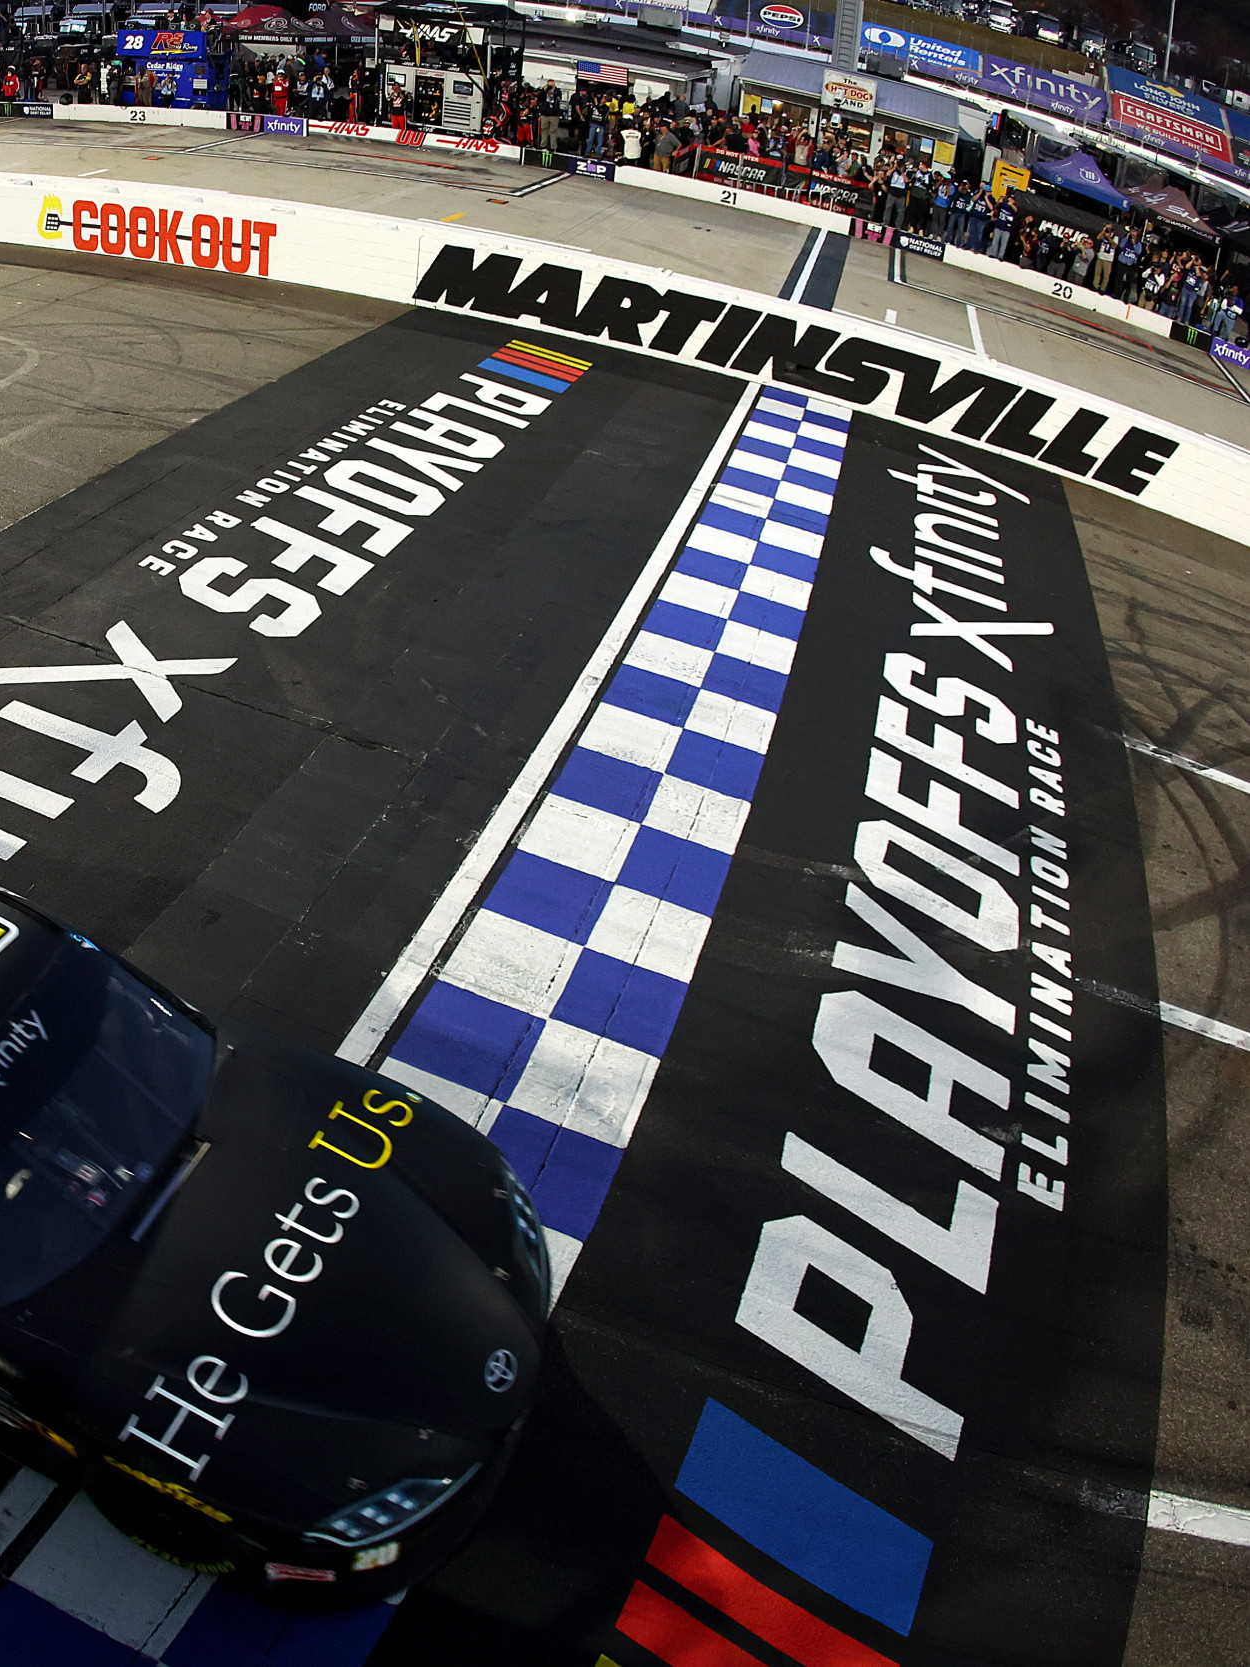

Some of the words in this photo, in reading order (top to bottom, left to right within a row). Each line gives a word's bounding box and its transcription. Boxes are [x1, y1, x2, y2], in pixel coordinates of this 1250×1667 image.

[308, 3, 327, 12] FORD
[763, 10, 801, 22] PEPSI
[755, 25, 781, 37] xfinity
[123, 34, 144, 50] 28
[910, 37, 962, 57] United
[910, 46, 966, 66] Rentals
[146, 62, 165, 70] Cedar
[166, 63, 184, 72] Ridge
[851, 90, 869, 100] DOG
[990, 63, 1102, 111] xfinity
[1133, 82, 1167, 99] LONG
[1170, 95, 1201, 112] JOHN
[130, 110, 146, 122] 23
[1127, 105, 1215, 145] CRAFTSMAN
[267, 121, 301, 134] xfinity
[1152, 128, 1180, 142] BUILD
[718, 161, 766, 181] NASCAR
[720, 190, 738, 205] 21
[814, 183, 858, 204] NASCAR
[72, 200, 185, 268] COOK
[191, 213, 277, 277] OUT
[908, 237, 943, 253] NATIONAL
[909, 244, 924, 253] DEBT
[924, 247, 942, 257] RELIEF
[1052, 282, 1073, 299] 20
[1214, 343, 1250, 365] xfinity
[414, 244, 1180, 496] MARTINSVILLE
[235, 398, 407, 509] ELIMINATION
[177, 372, 554, 638] PLAYOFFS
[137, 509, 242, 577] RACE
[869, 444, 1054, 673] xfinity
[1025, 718, 1065, 817] RACE
[1017, 825, 1074, 1212] ELIMINATION
[735, 652, 1020, 1462] PLAYOFFS
[118, 1354, 249, 1482] He
[210, 1176, 361, 1339] Gets
